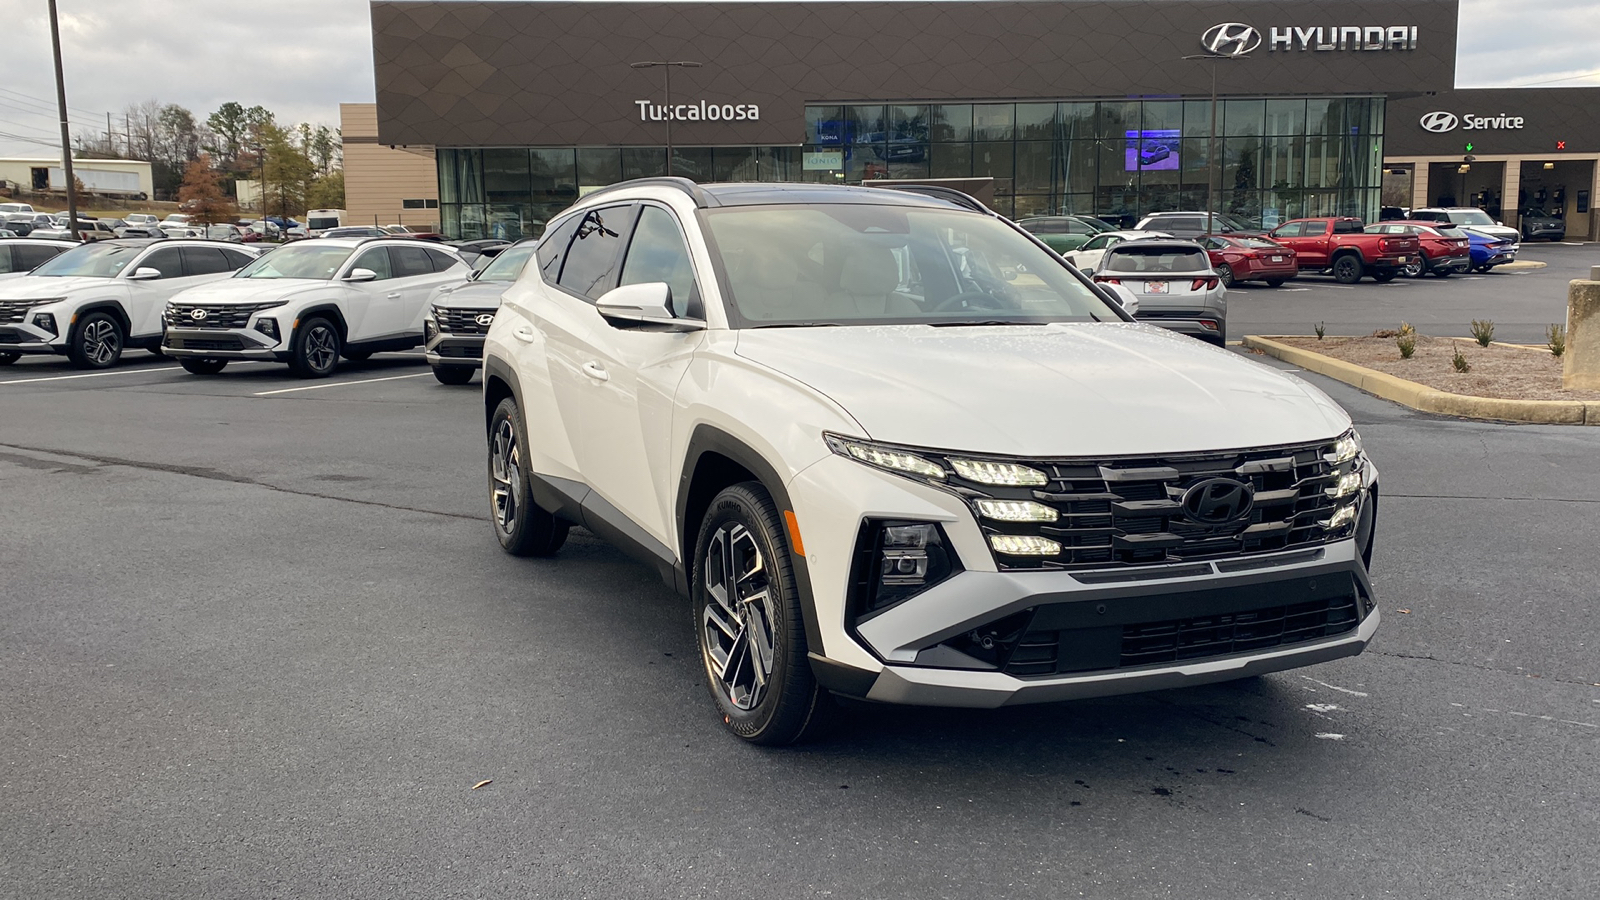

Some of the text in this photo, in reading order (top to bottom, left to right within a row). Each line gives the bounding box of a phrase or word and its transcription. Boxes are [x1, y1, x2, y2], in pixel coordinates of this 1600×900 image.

[1270, 26, 1418, 51] HYUNDAI
[634, 99, 760, 121] Tuscaloosa
[1462, 112, 1524, 130] Service
[717, 500, 742, 512] KUMHO
